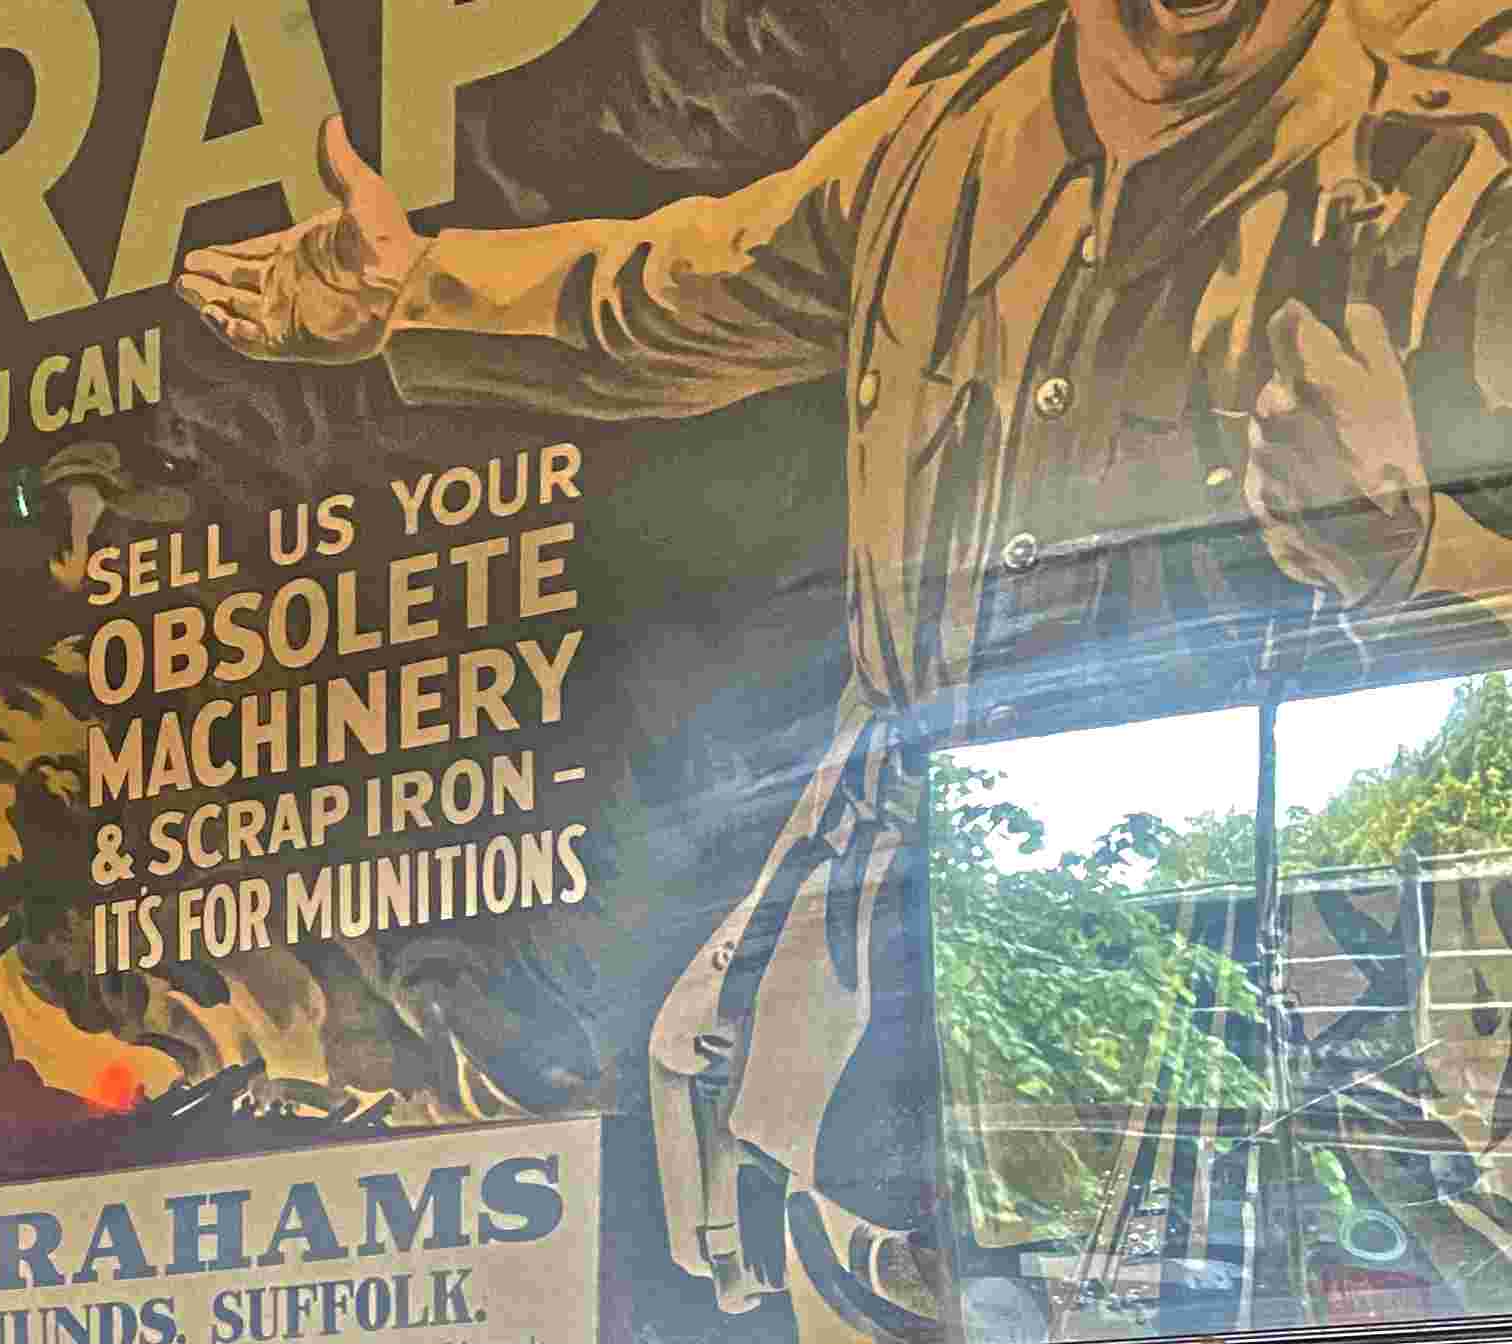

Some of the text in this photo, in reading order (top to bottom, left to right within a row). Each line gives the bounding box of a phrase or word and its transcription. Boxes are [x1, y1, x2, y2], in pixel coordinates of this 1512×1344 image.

[28, 327, 161, 432] CAN
[87, 443, 584, 606] SELL US YOUR
[88, 522, 578, 705] OBSOLETE
[88, 631, 584, 807] MACHINERY
[91, 750, 534, 886] & SCRAP IRON
[93, 823, 587, 975] IT'S FOR MUNITIONS
